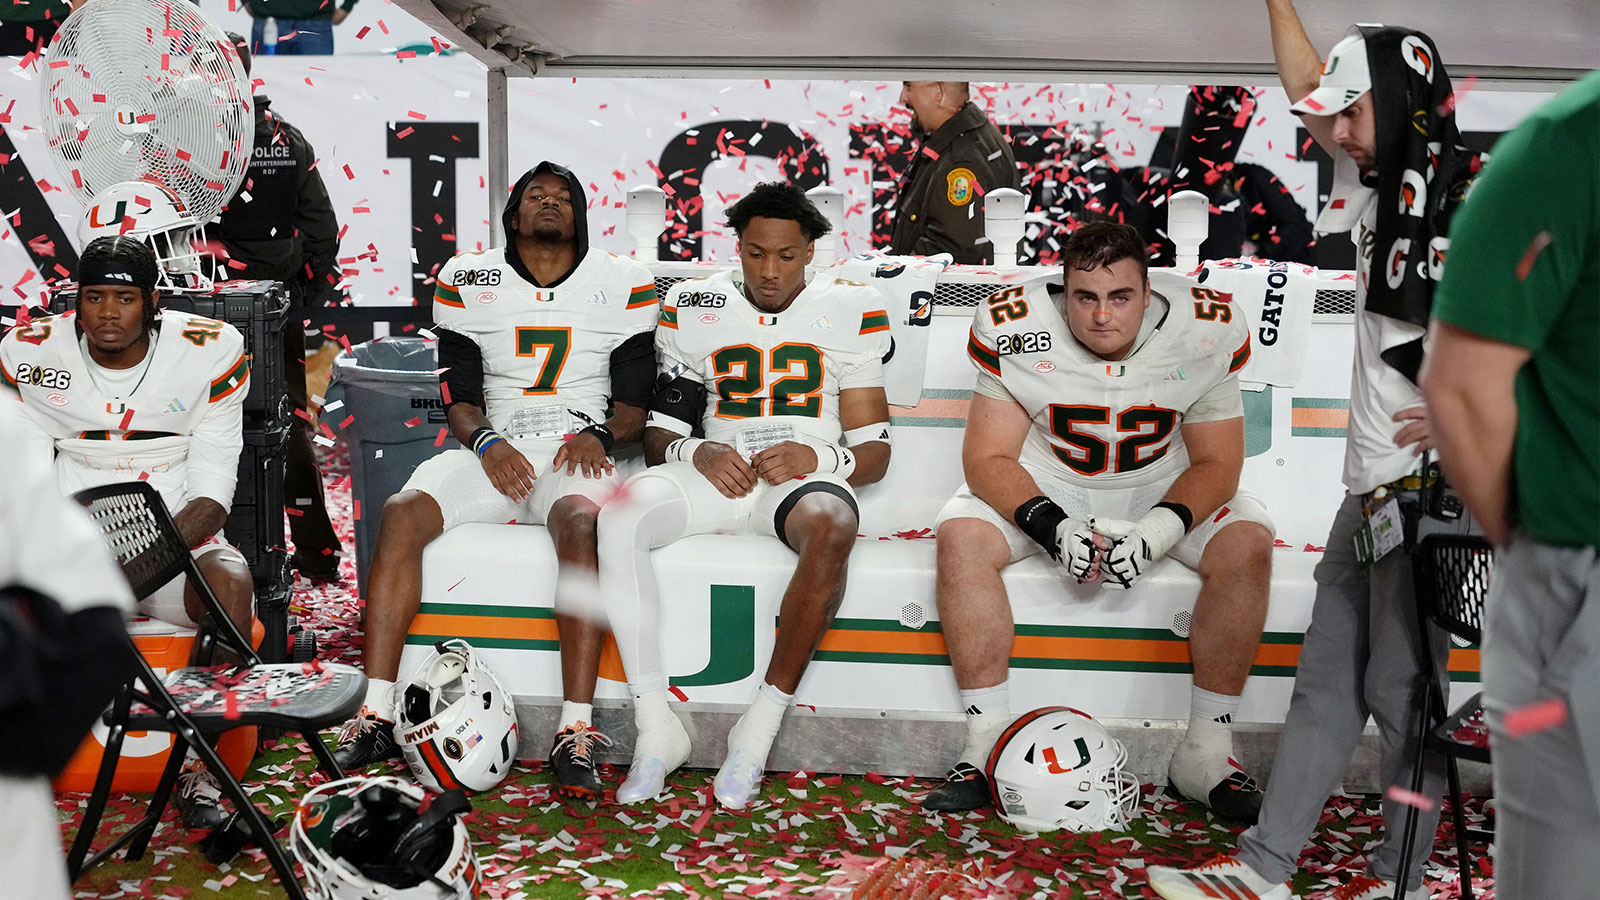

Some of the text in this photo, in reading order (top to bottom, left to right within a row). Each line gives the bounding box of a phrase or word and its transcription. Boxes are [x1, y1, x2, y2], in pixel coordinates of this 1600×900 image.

[1321, 56, 1339, 76] U
[118, 112, 135, 125] U
[252, 147, 290, 158] OLICE
[90, 201, 128, 228] U
[453, 269, 502, 287] 2026
[536, 291, 554, 302] U
[676, 291, 727, 308] 2026
[987, 285, 1030, 327] 52
[759, 316, 777, 326] U
[996, 332, 1051, 355] 2026
[515, 326, 572, 396] 7
[1105, 365, 1125, 378] U
[16, 363, 72, 390] 2026
[711, 341, 824, 419] 22
[106, 402, 125, 414] U
[1049, 403, 1177, 477] 52
[404, 721, 440, 744] MIAMI
[1042, 737, 1091, 774] U
